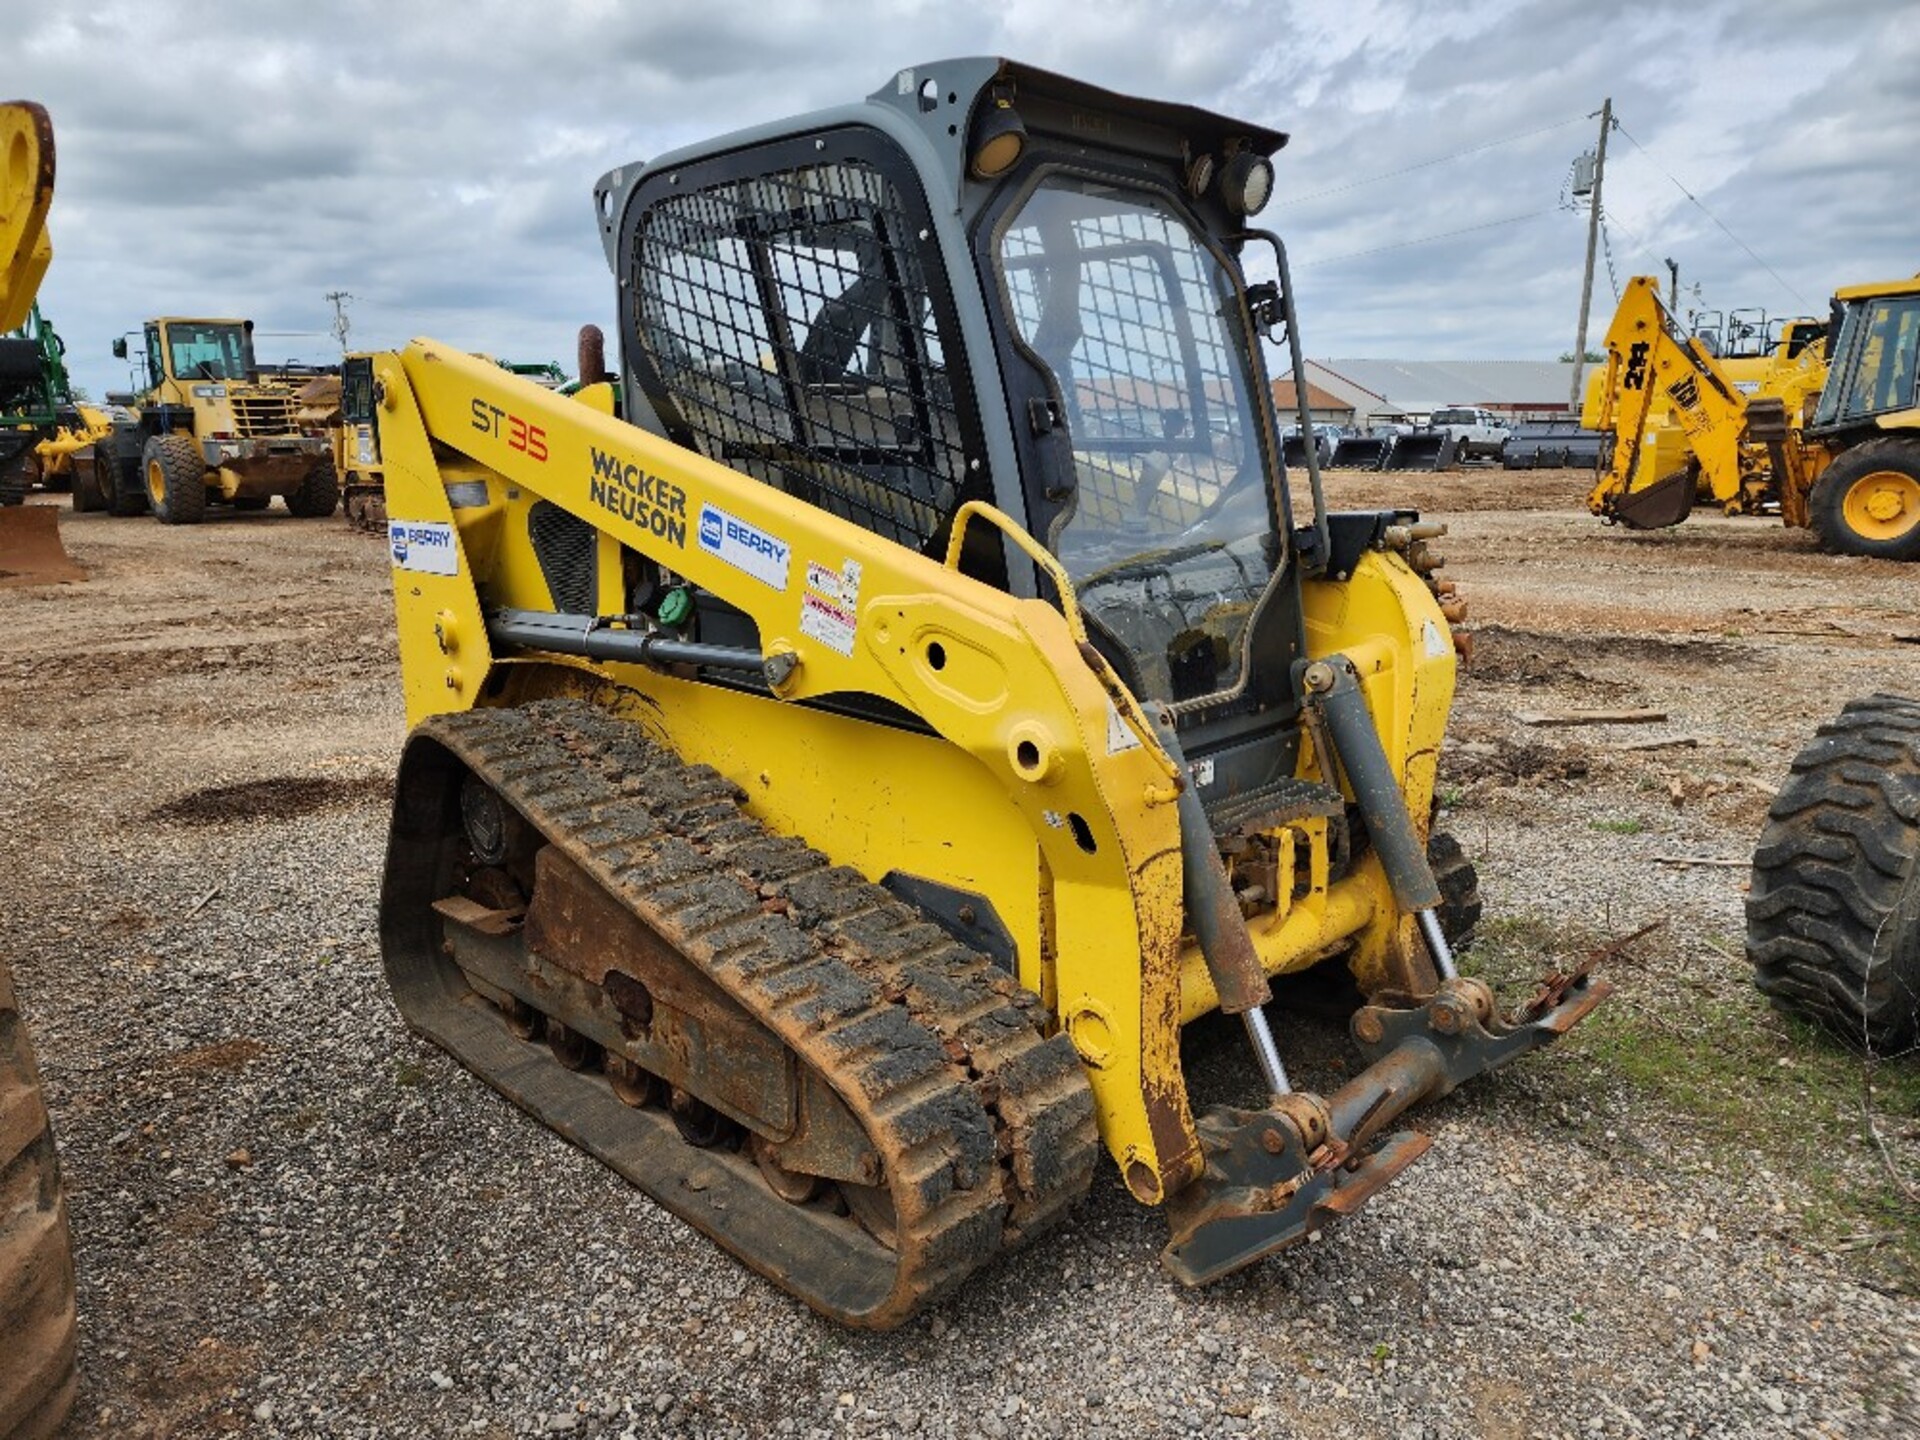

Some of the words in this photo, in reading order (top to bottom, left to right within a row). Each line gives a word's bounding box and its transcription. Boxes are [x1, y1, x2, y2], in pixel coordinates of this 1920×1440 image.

[590, 446, 686, 518] WACKER
[409, 528, 450, 548] BERRY
[590, 475, 686, 549] NEUSON
[727, 520, 786, 563] BERRY
